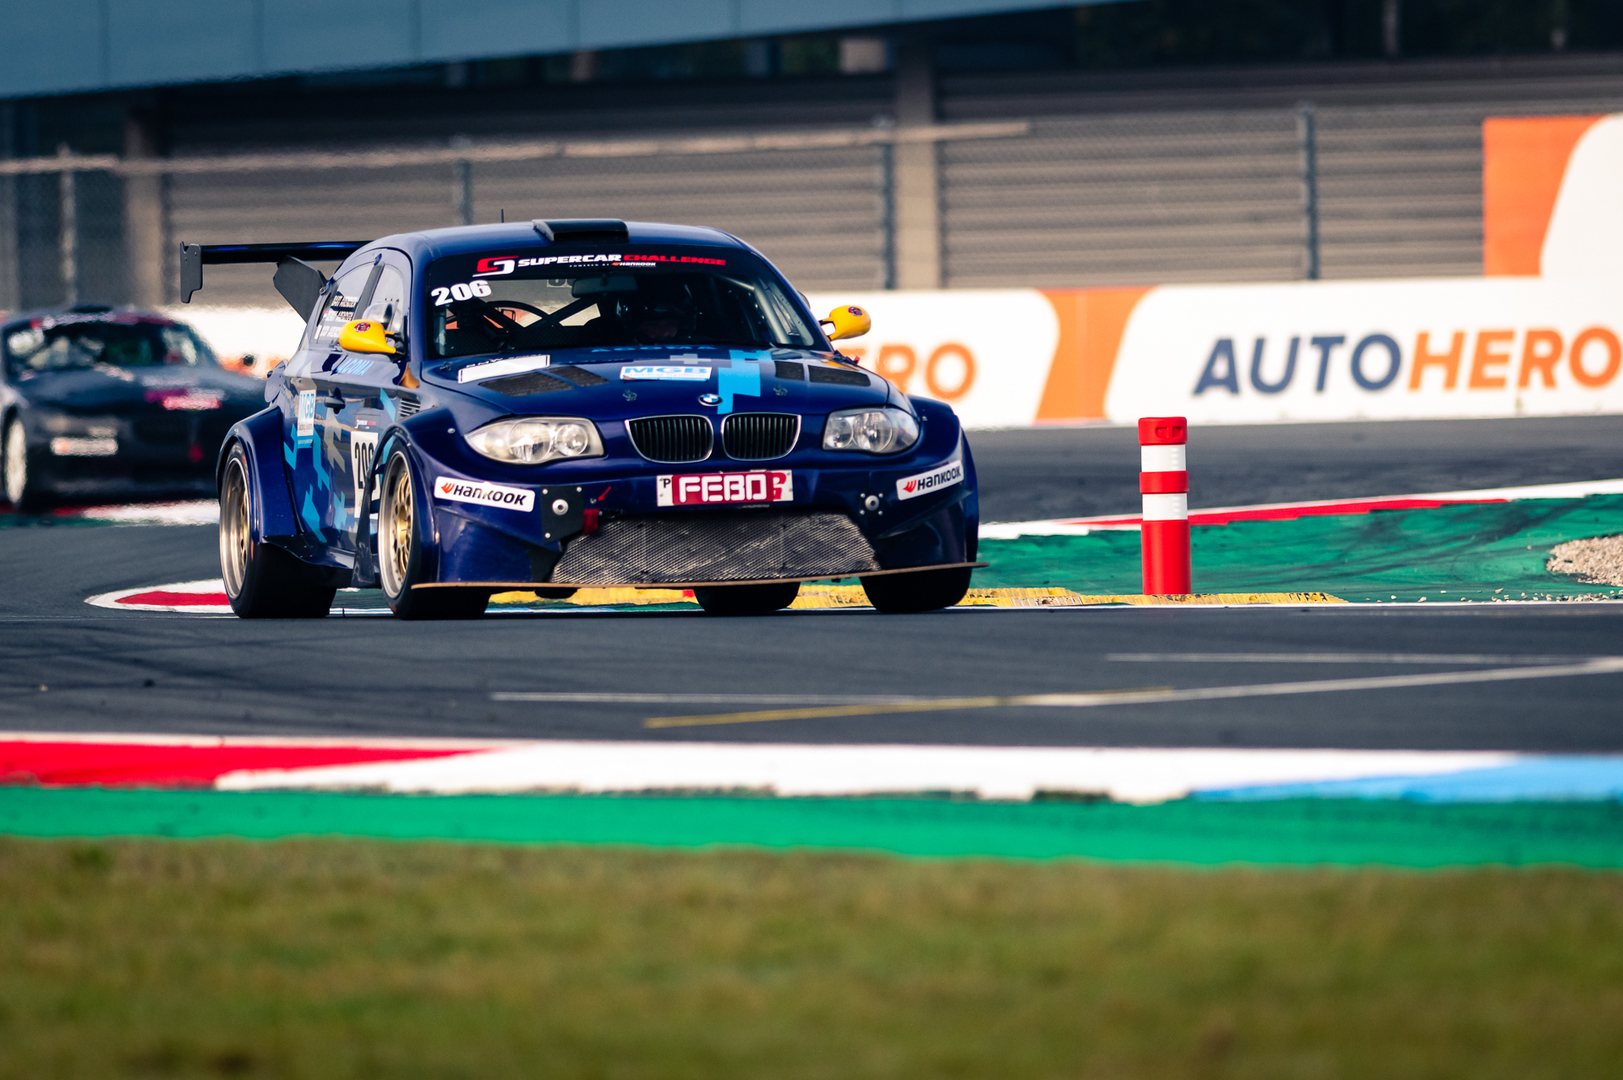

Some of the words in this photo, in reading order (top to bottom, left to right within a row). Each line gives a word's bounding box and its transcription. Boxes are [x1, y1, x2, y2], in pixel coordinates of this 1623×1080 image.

[517, 254, 622, 268] SUPERCAR
[623, 254, 727, 266] CHALLENGE
[431, 280, 492, 306] 206
[1192, 327, 1623, 396] AUTOHERO
[679, 474, 767, 503] FEBO
